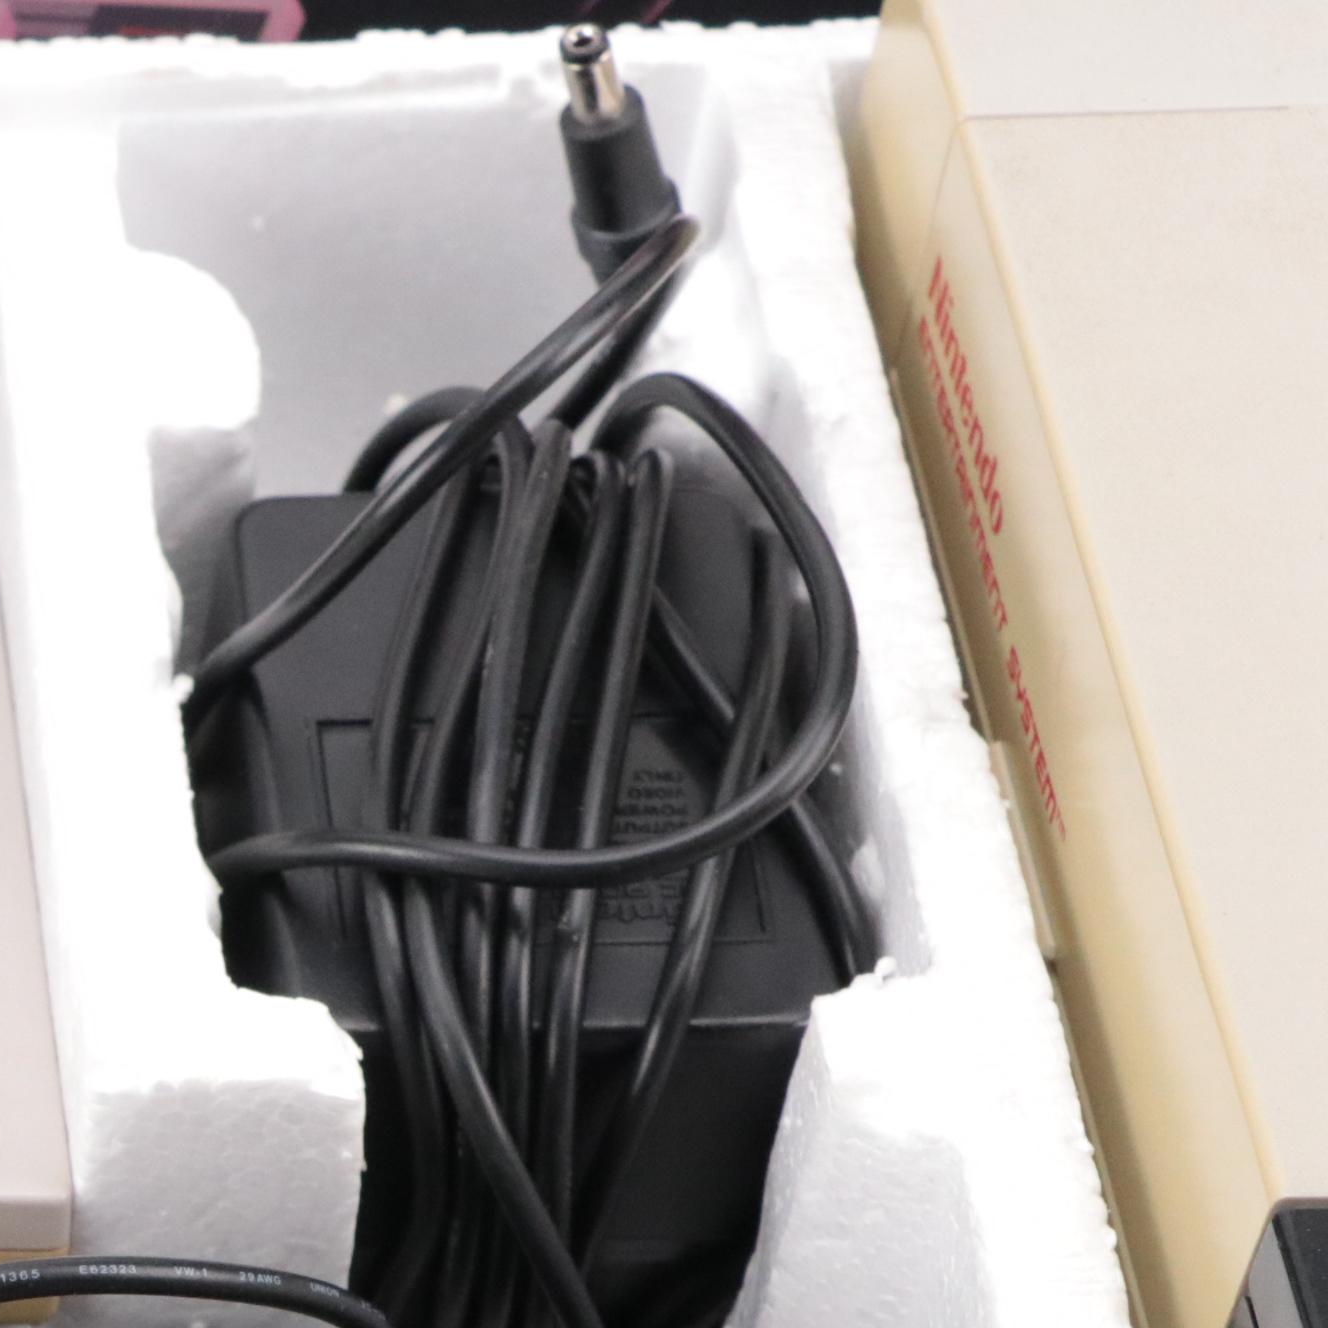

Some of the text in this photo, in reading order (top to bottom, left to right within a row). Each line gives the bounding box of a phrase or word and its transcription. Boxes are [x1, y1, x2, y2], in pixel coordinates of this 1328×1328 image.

[918, 315, 1008, 631] ENTERTAINMENT
[928, 256, 1004, 535] Nintendo
[174, 1266, 209, 1278] VW-1
